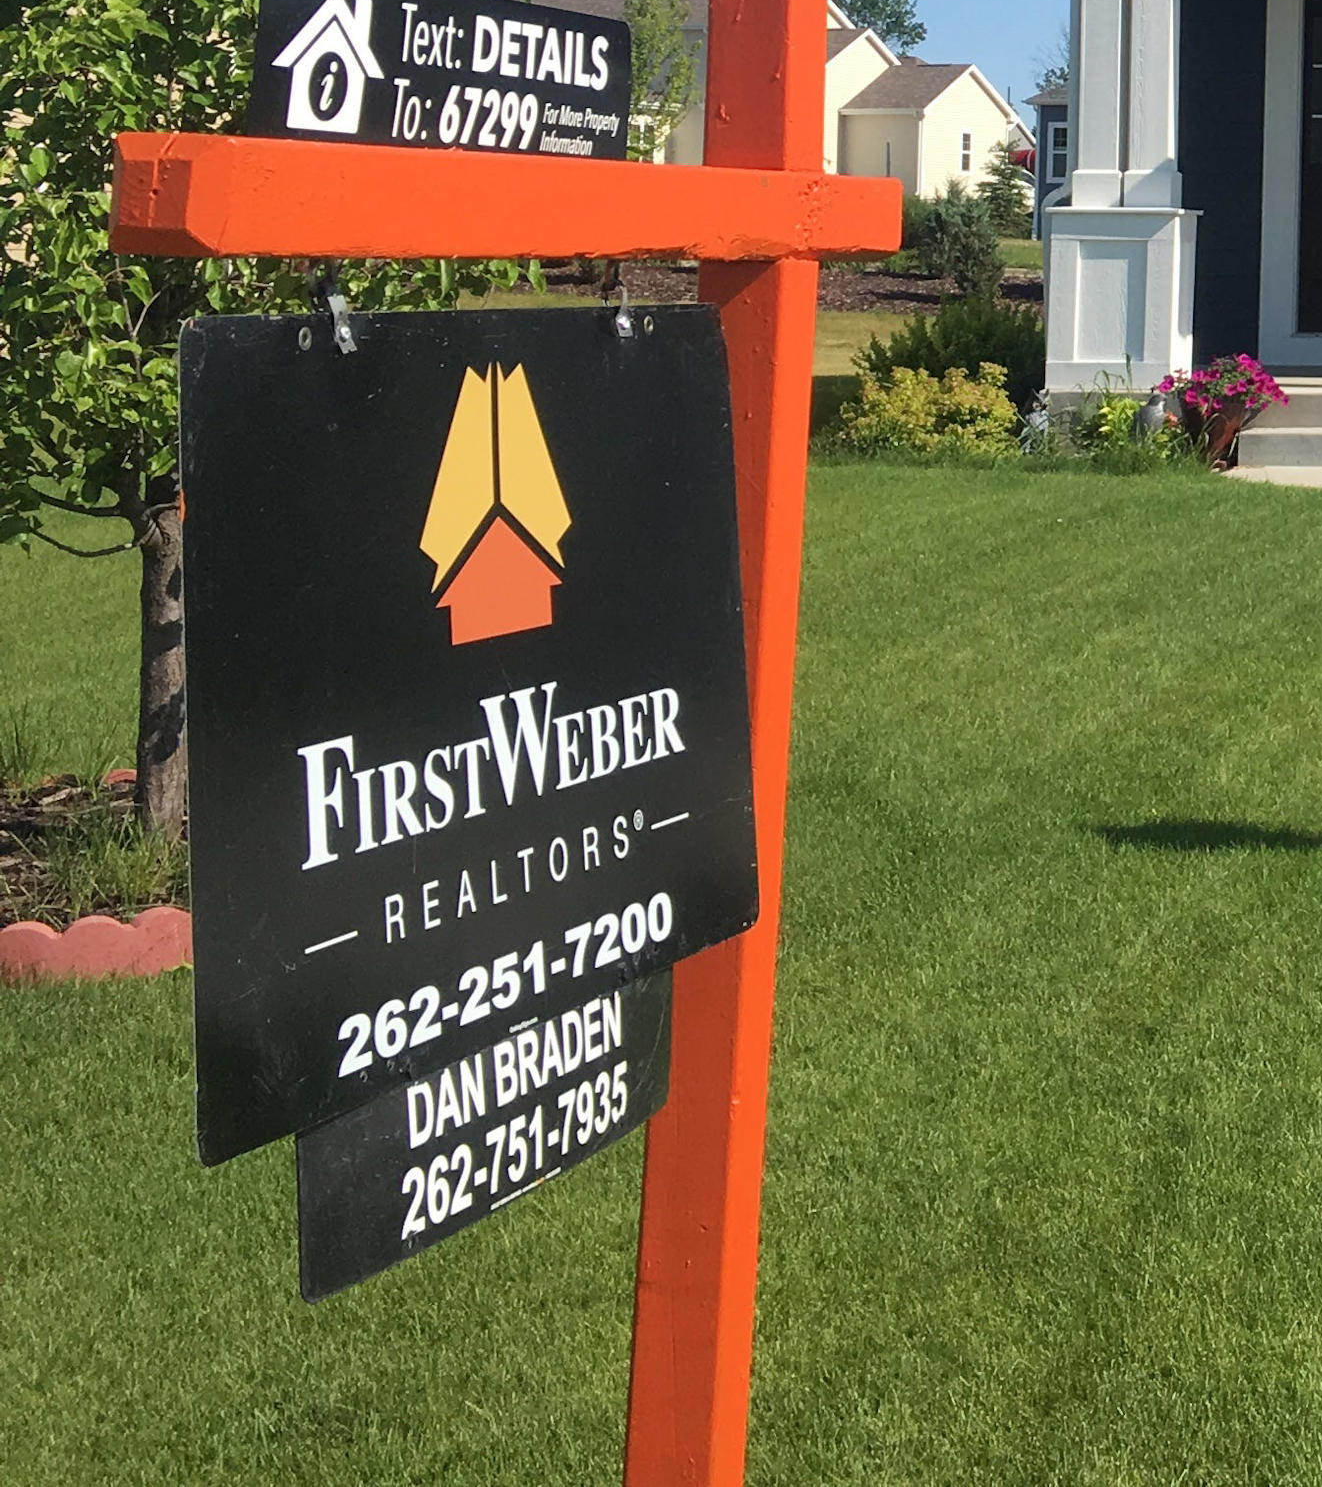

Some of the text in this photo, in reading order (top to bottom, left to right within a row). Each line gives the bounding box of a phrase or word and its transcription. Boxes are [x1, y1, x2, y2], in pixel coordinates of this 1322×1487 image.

[401, 2, 610, 91] Text: DETAILS
[391, 78, 539, 150] To: 67299
[539, 130, 593, 156] Information
[542, 103, 620, 138] For More Property
[337, 891, 674, 1079] 262-251-7200
[405, 990, 622, 1149] DAN BRADEN
[401, 1061, 628, 1241] 262-751-7935
